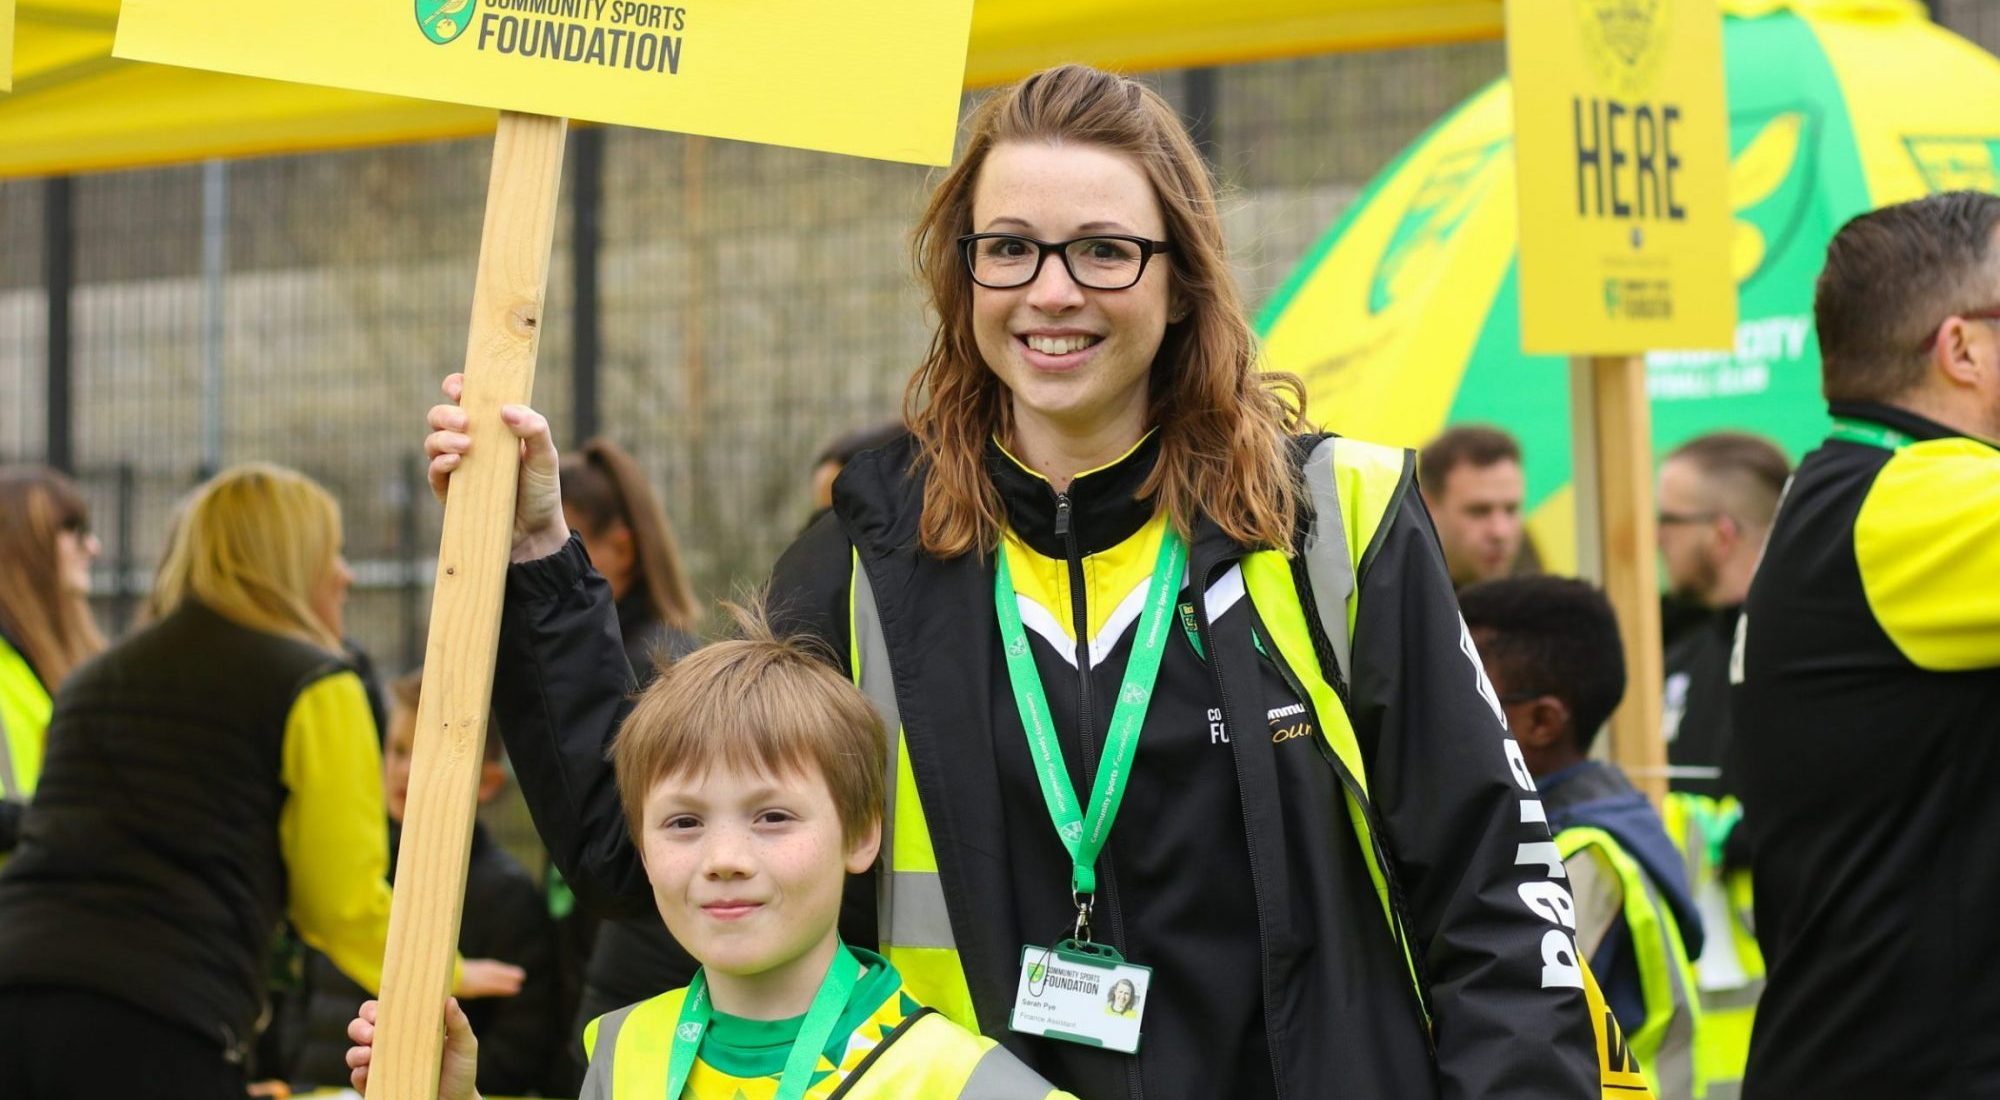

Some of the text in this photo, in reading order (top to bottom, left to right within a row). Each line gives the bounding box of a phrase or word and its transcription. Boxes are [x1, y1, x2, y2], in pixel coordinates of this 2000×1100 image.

[610, 0, 686, 31] SPORTS
[477, 13, 683, 75] FOUNDATION
[1573, 96, 1687, 220] HERE
[1045, 974, 1099, 995] FOUNDATION
